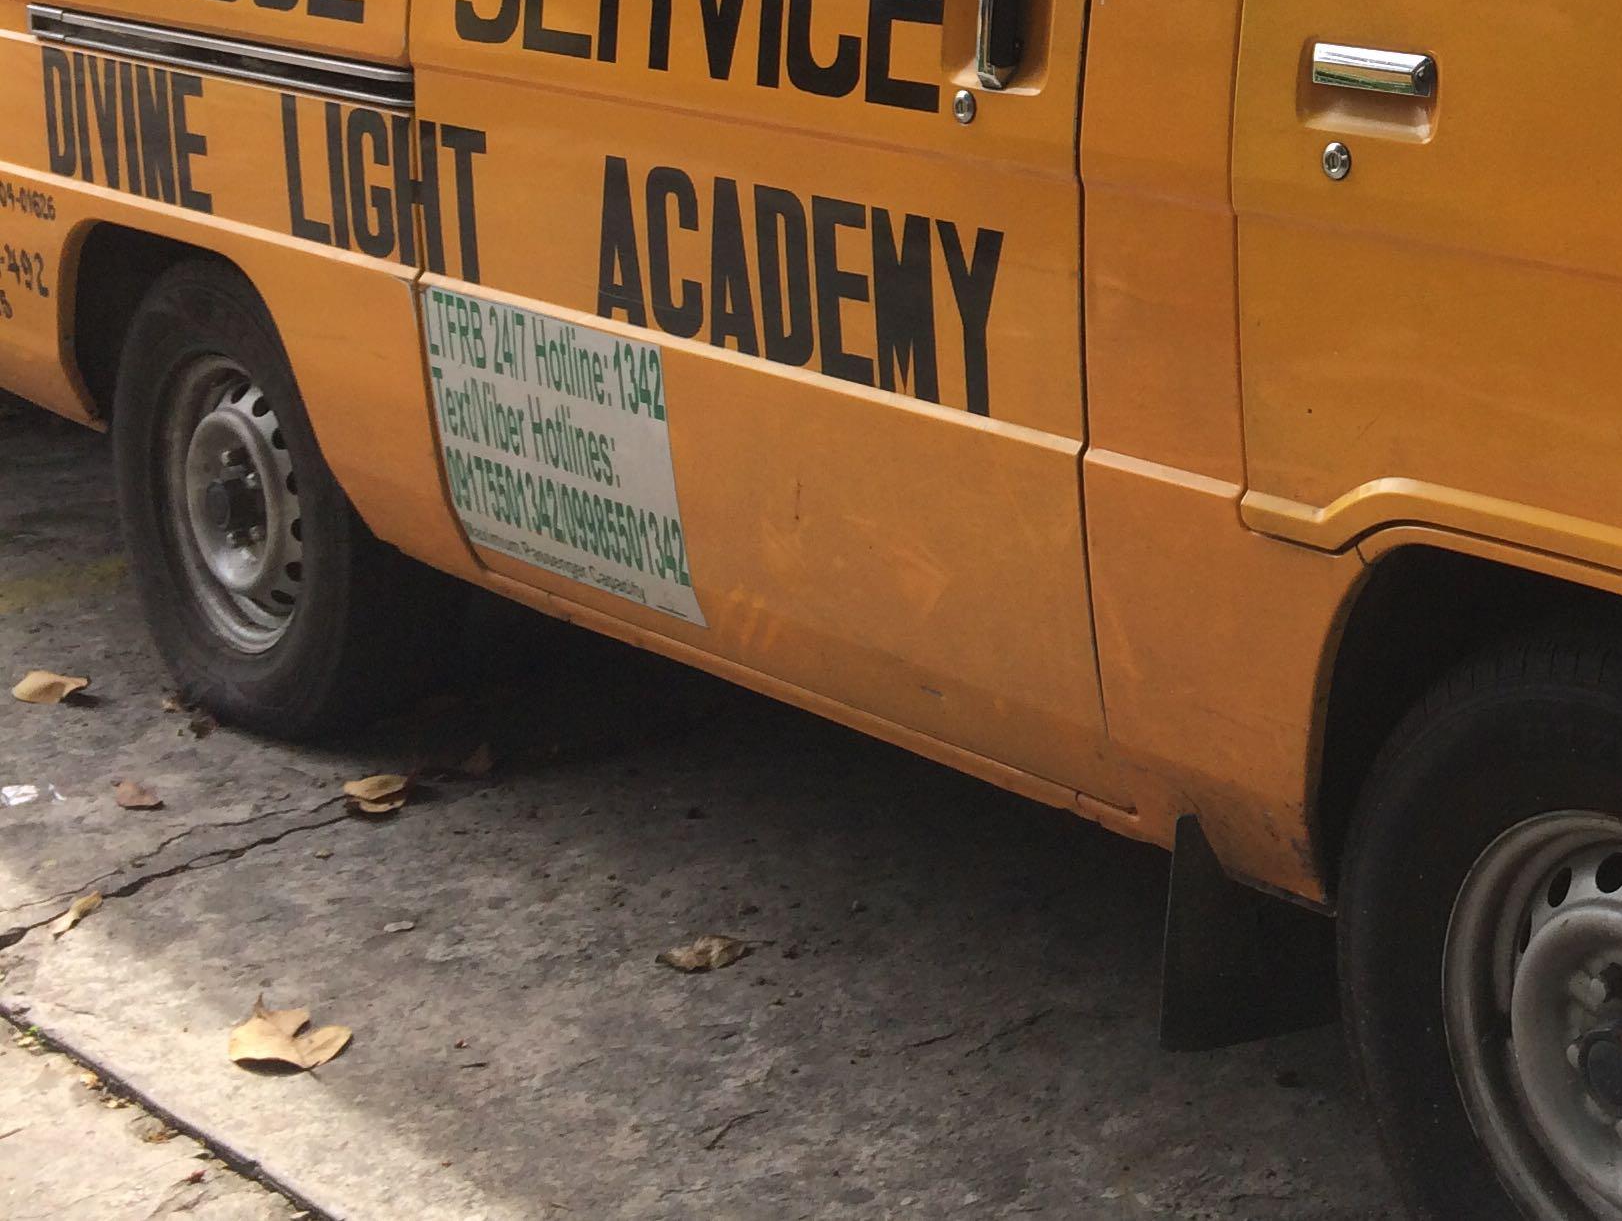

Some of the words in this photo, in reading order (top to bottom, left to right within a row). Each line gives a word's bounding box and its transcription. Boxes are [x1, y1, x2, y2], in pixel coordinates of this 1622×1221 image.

[42, 46, 213, 214] DIVINE
[280, 94, 486, 285] LIGHT
[597, 154, 1004, 418] ACADEMY
[424, 290, 487, 370] LTFRB
[489, 306, 527, 382] 24/7
[532, 316, 612, 406] Hotline:
[613, 340, 666, 421] 1342
[432, 366, 527, 458] Text/Viber
[527, 394, 621, 489] Hotlines:
